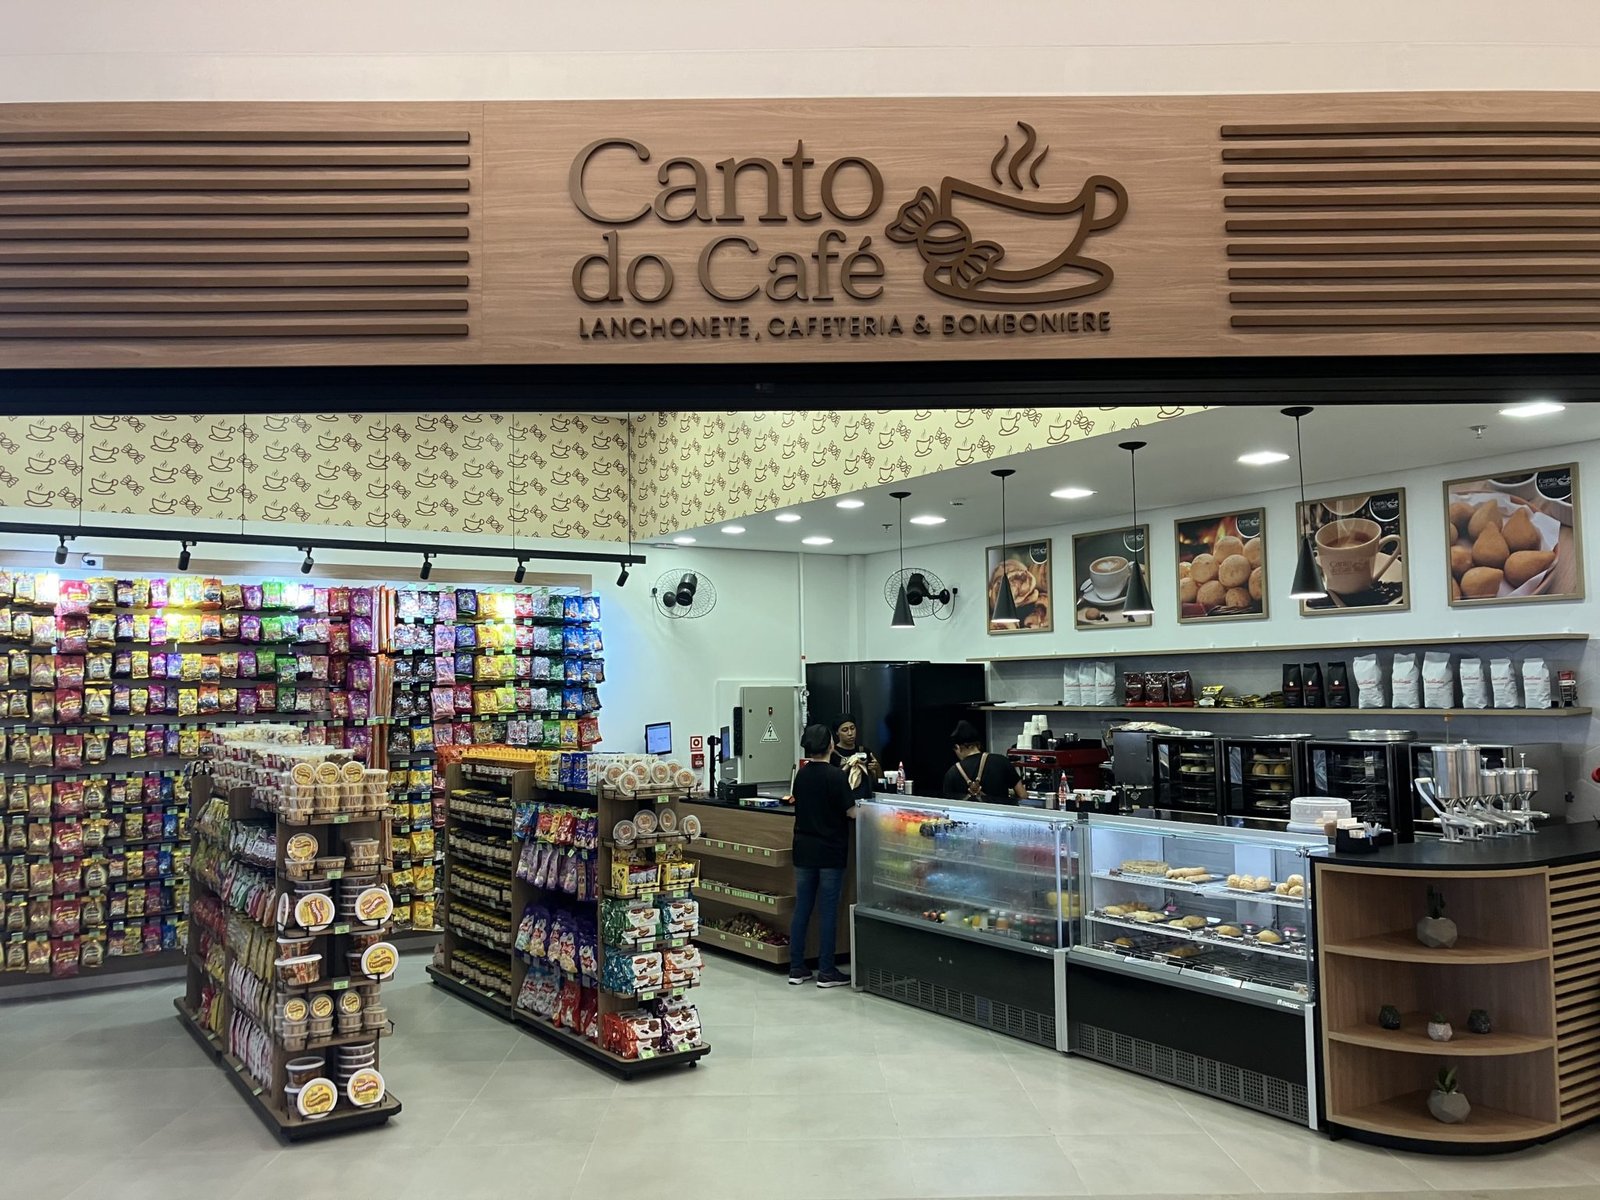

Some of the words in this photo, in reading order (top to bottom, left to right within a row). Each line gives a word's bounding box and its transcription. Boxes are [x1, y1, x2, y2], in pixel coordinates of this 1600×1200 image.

[569, 137, 884, 223] Canto
[571, 230, 674, 303] do
[699, 229, 886, 302] Café
[579, 316, 762, 341] LANCHONETE,
[767, 313, 903, 337] CAFETERIA
[912, 313, 931, 334] &
[942, 311, 1112, 334] BOMBONIERE
